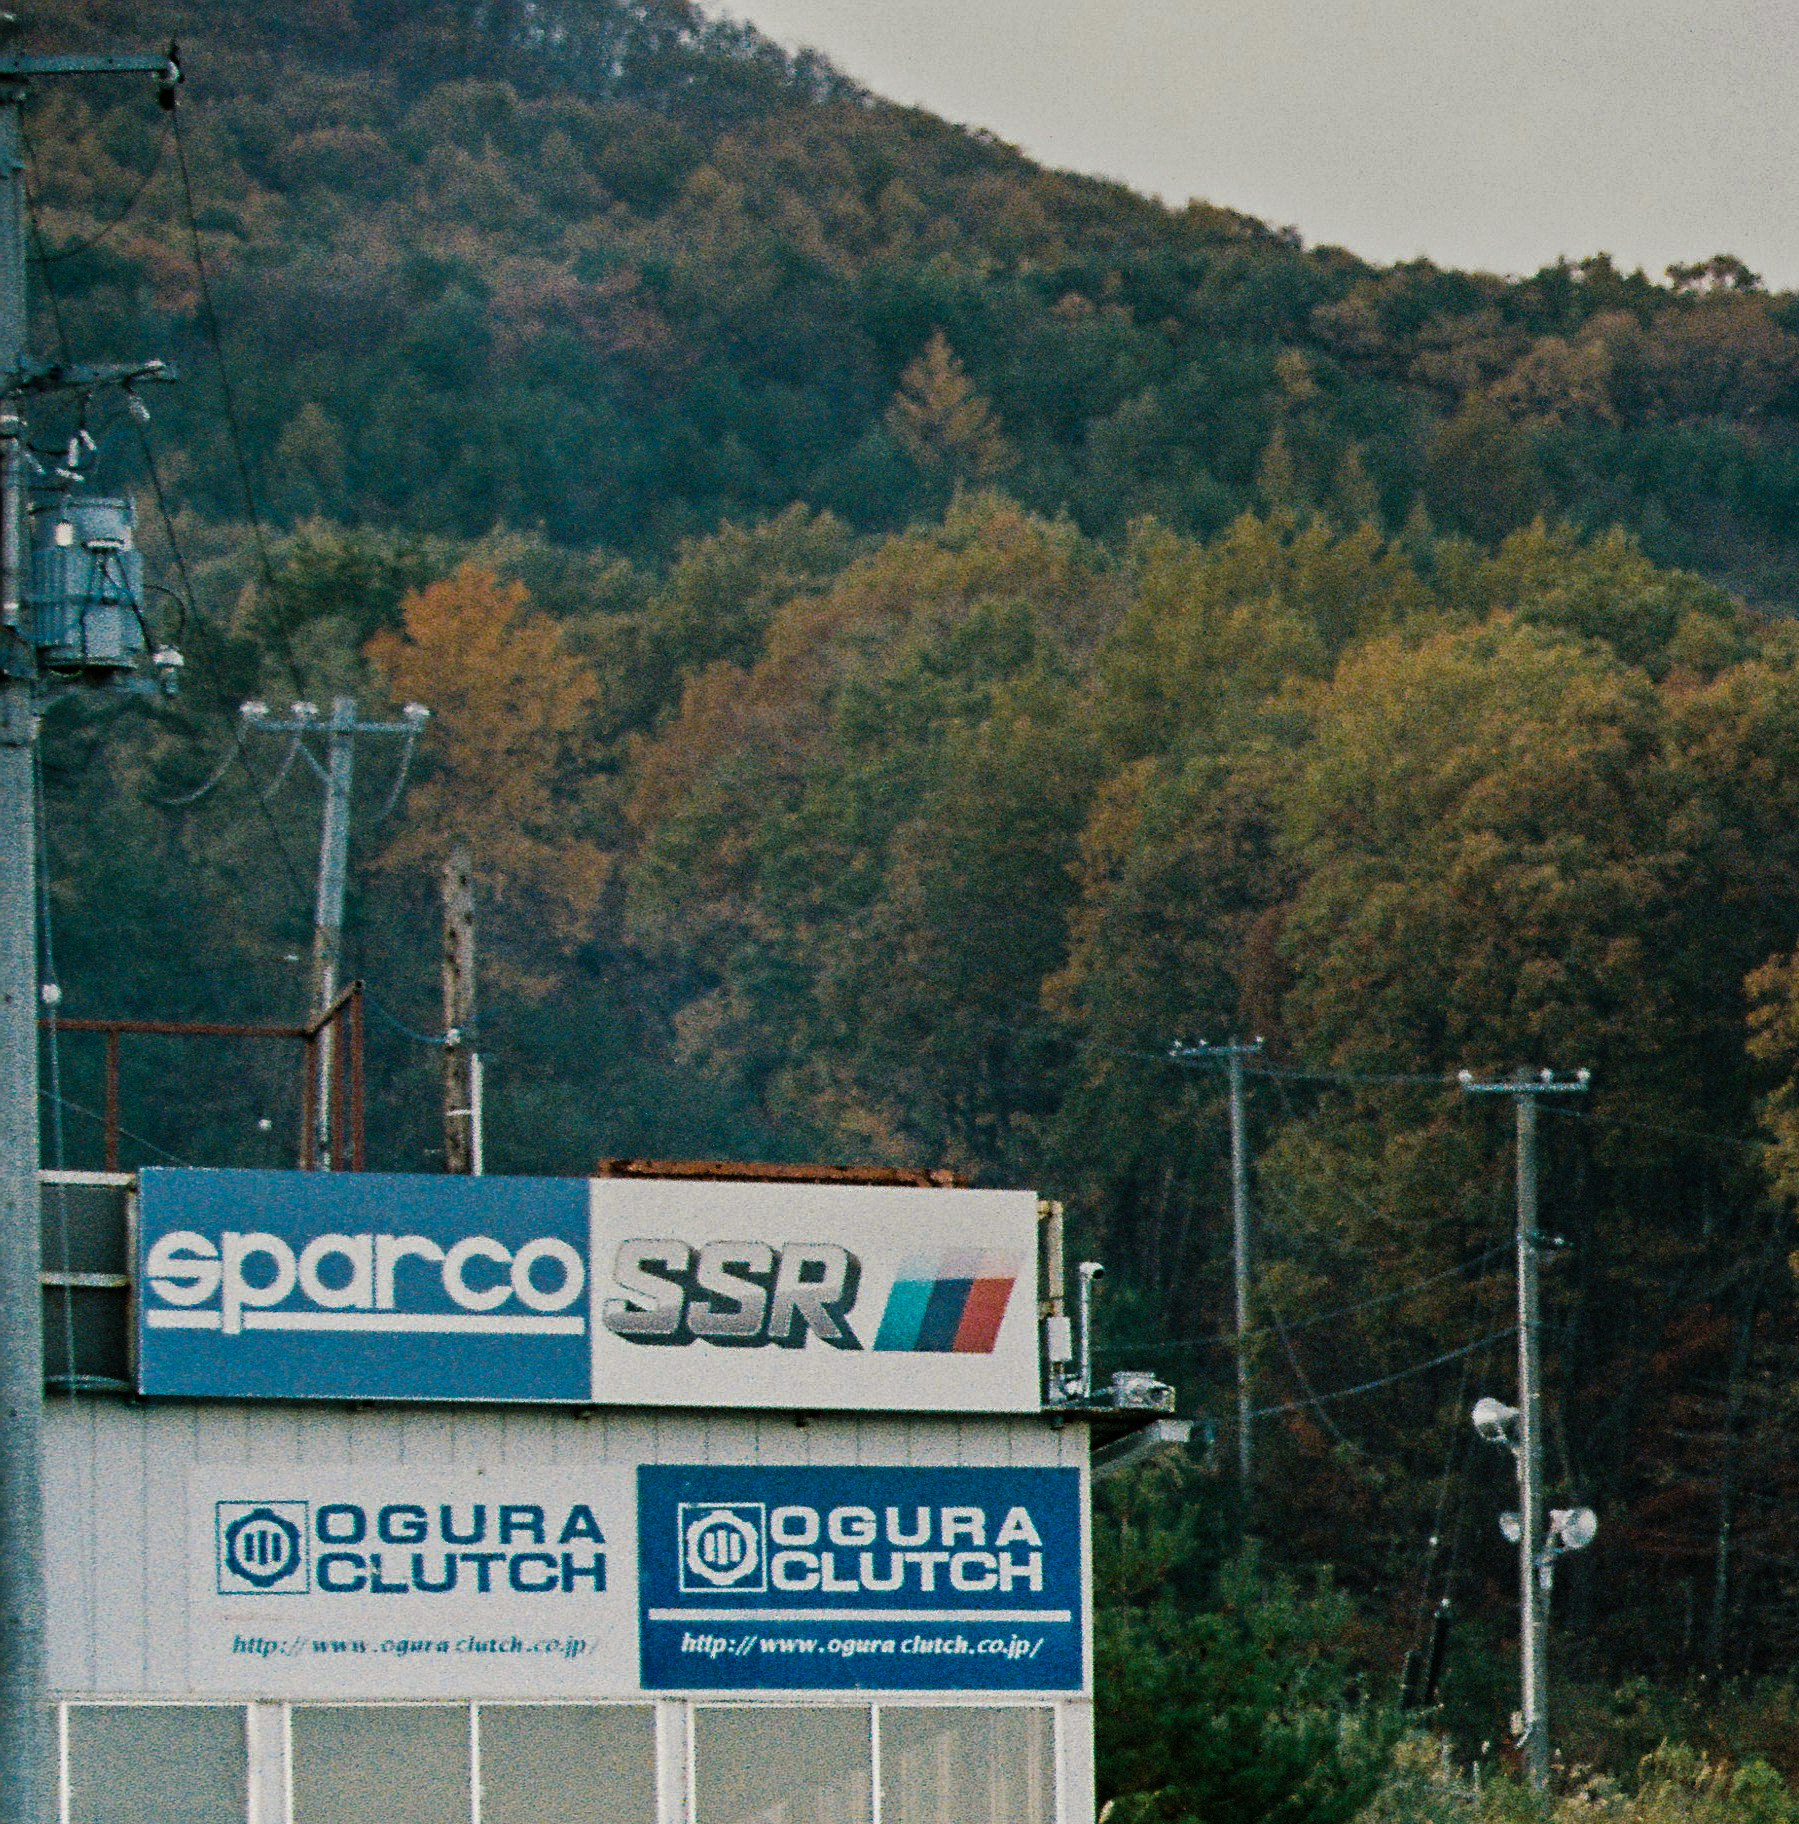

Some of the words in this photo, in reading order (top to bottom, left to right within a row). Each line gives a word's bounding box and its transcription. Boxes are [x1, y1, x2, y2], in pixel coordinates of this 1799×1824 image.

[147, 1231, 585, 1335] sparco
[602, 1237, 865, 1350] SSR
[315, 1503, 607, 1545] OGURA
[770, 1505, 1043, 1547] OGURA
[316, 1552, 607, 1594] CLUTCH
[770, 1550, 1043, 1592] CLUTCH
